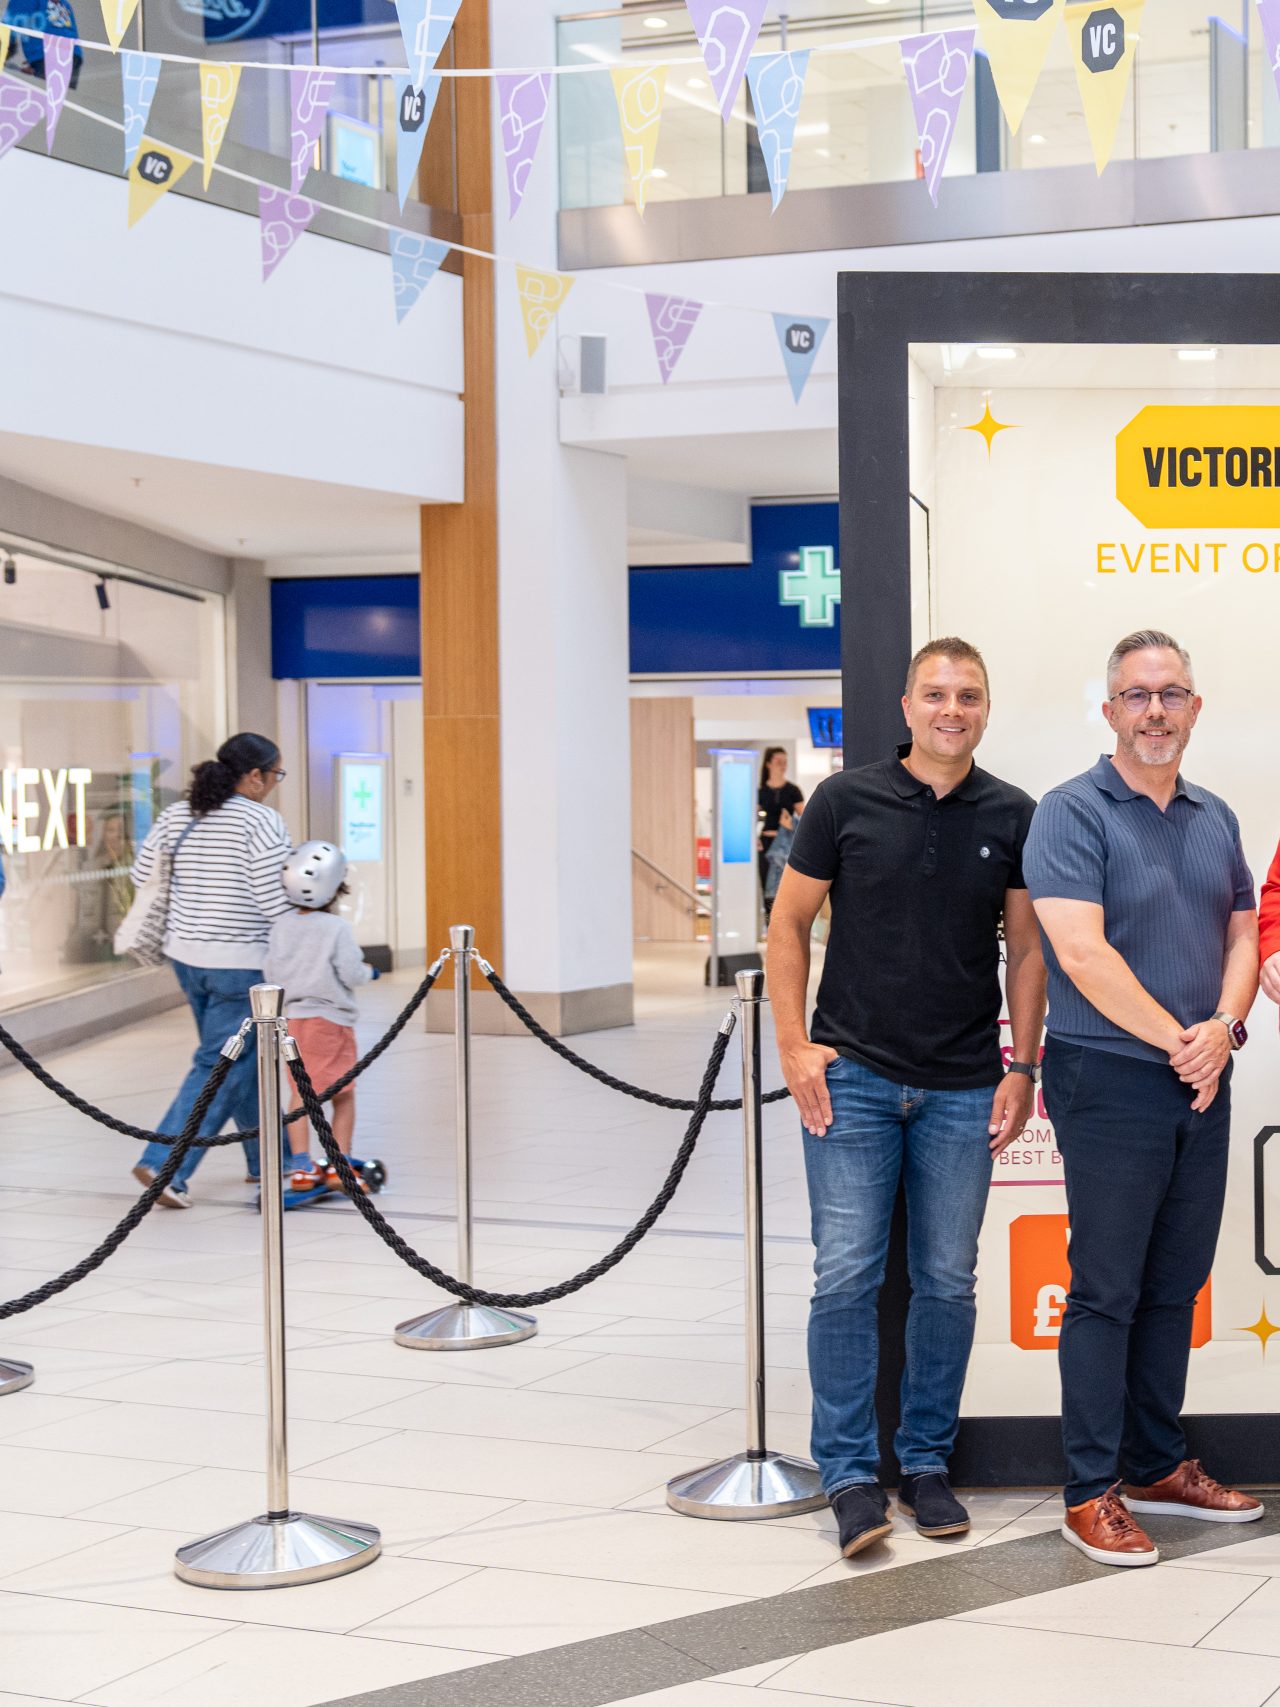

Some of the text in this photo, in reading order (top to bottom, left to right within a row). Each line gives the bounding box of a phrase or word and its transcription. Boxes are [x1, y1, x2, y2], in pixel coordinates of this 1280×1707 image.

[1089, 23, 1116, 58] VC
[404, 95, 421, 121] VC
[144, 155, 168, 179] VC
[790, 329, 811, 348] VC
[1096, 543, 1228, 573] EVENT
[1000, 1150, 1045, 1165] BEST
